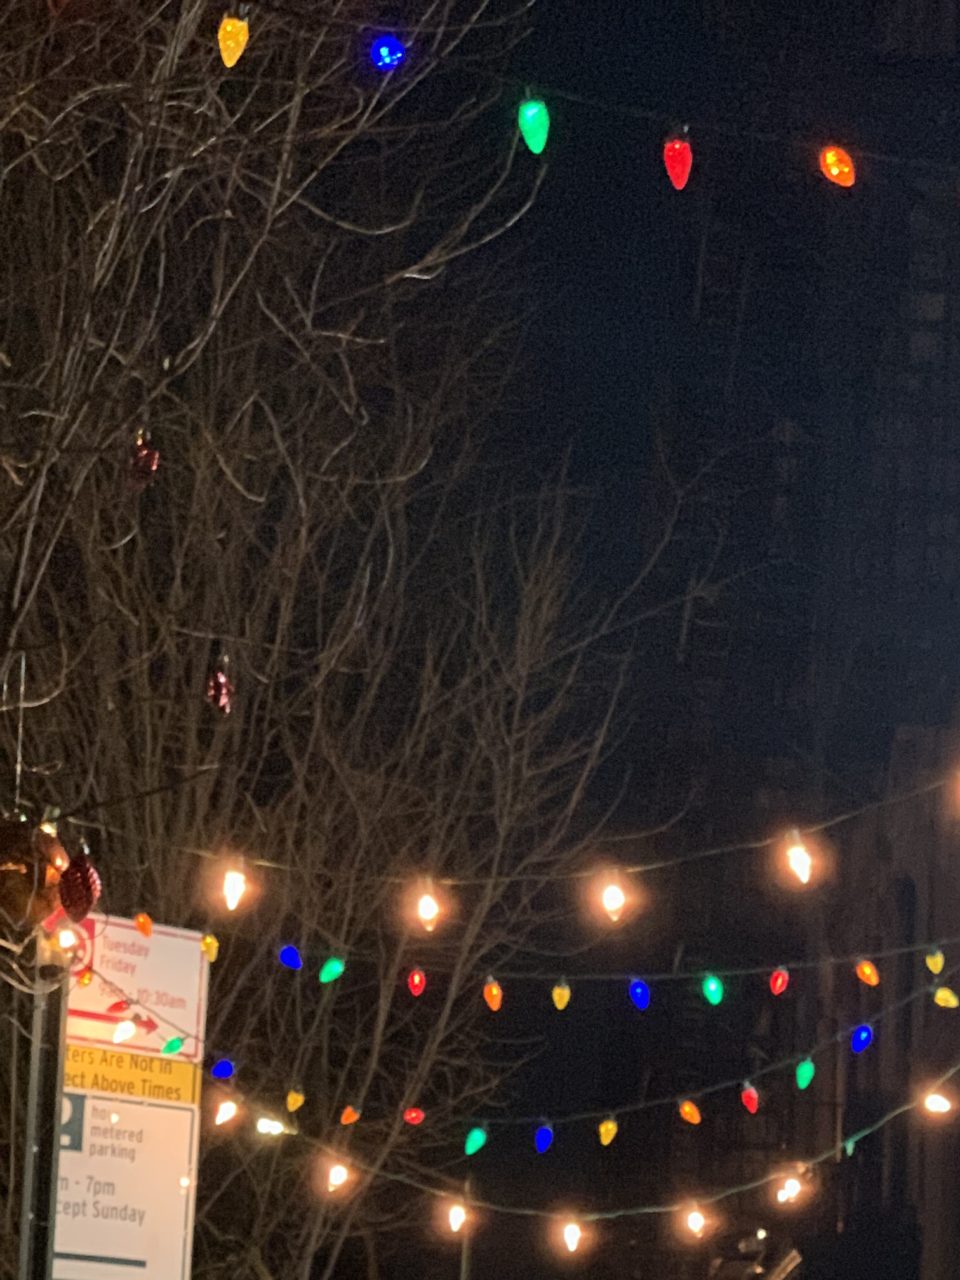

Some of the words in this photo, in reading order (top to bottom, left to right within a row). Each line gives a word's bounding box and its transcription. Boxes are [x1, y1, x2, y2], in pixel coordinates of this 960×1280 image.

[102, 934, 150, 960] Tuesday
[100, 954, 137, 977] Friday
[99, 1049, 125, 1069] Are
[129, 1054, 154, 1073] Not
[91, 1073, 135, 1095] Above
[141, 1079, 182, 1101] Times
[91, 1125, 143, 1144] metered
[89, 1143, 137, 1164] parking
[85, 1174, 116, 1198] 7pm
[92, 1200, 147, 1228] Sunday
